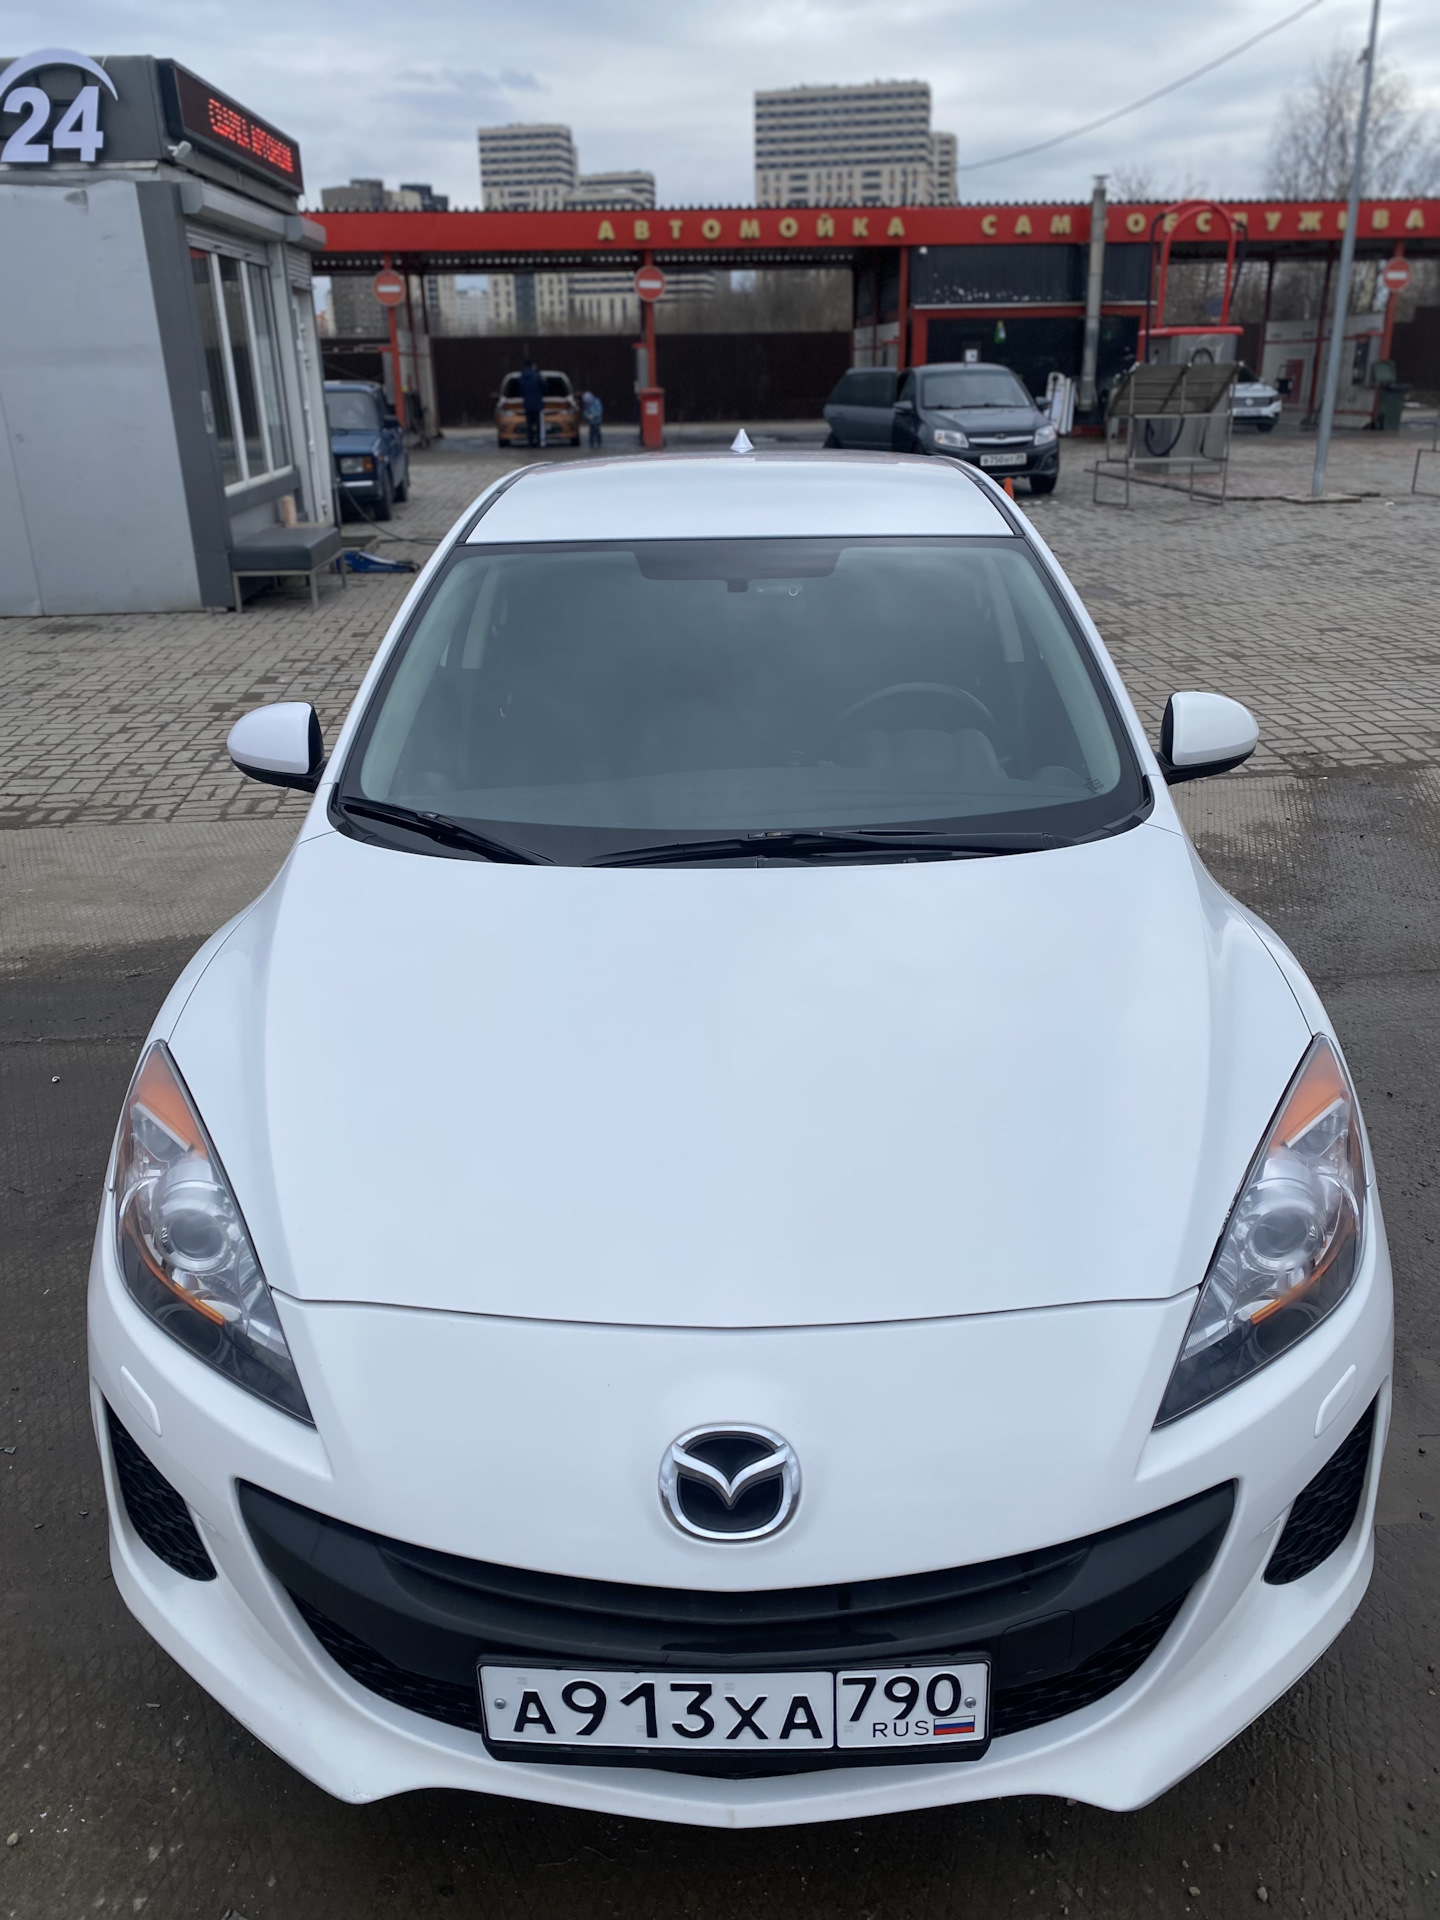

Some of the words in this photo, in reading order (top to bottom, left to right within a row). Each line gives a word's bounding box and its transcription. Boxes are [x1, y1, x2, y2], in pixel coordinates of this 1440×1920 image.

[1, 86, 103, 162] 24
[597, 214, 905, 240] АВТОМОЙКА
[513, 1678, 823, 1740] А913ХА
[843, 1672, 963, 1722] 790
[872, 1720, 931, 1738] RUS
